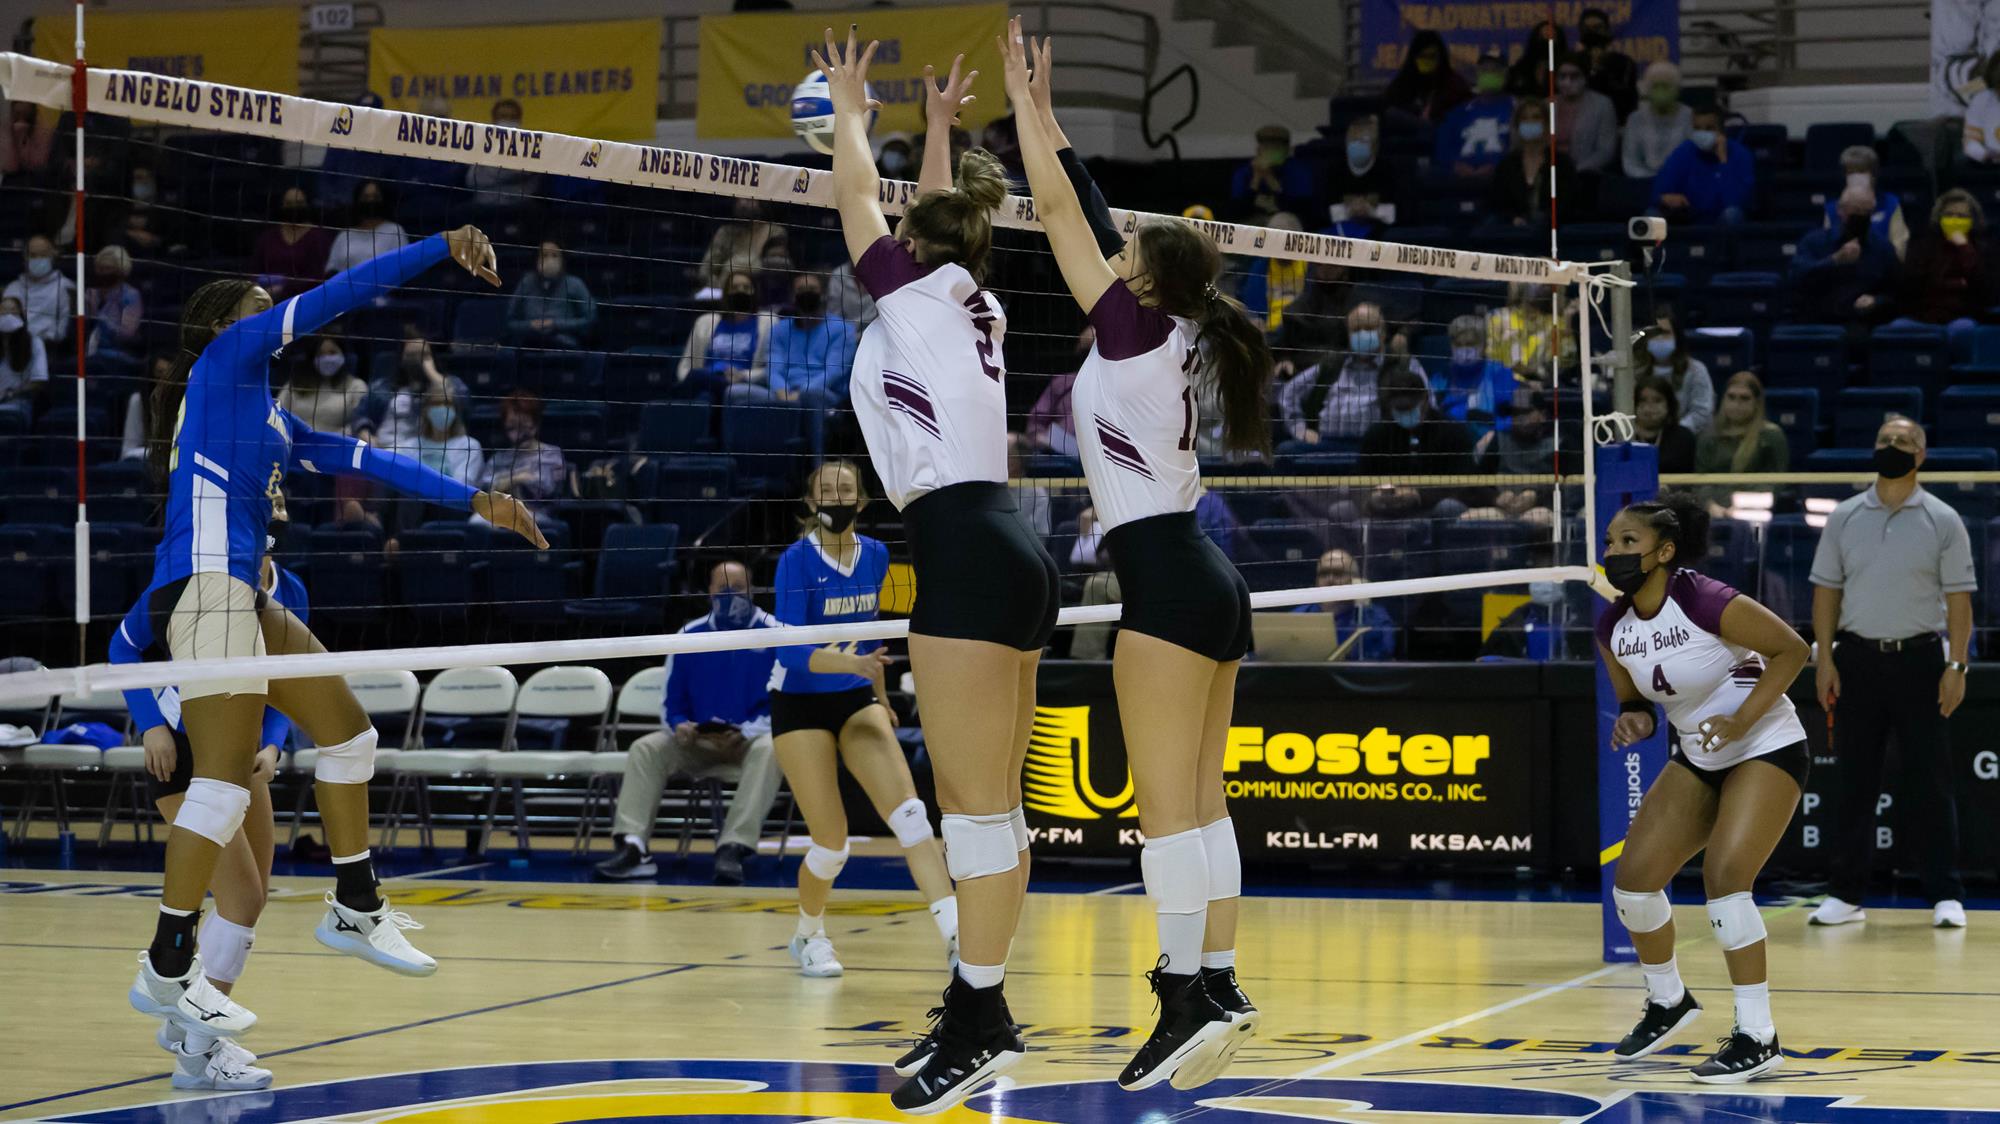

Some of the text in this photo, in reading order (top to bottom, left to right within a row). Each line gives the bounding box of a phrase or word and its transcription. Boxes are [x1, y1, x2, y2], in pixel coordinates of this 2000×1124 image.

[315, 8, 349, 25] 102
[512, 67, 634, 95] CLEANERS
[105, 73, 283, 125] ANGELO STATE
[397, 114, 543, 159] ANGELO STATE
[638, 147, 760, 187] ANGELO STATE
[1284, 232, 1353, 259] ANGELO STATE
[1618, 626, 1690, 658] Lady Buffs
[1652, 664, 1677, 696] 4
[1223, 727, 1490, 776] Foster
[1401, 782, 1443, 802] CO.,
[1447, 784, 1487, 801] INC.
[1625, 752, 1642, 806] sports
[1266, 832, 1378, 848] KCLL-FM
[1410, 834, 1532, 851] KKSA-AM
